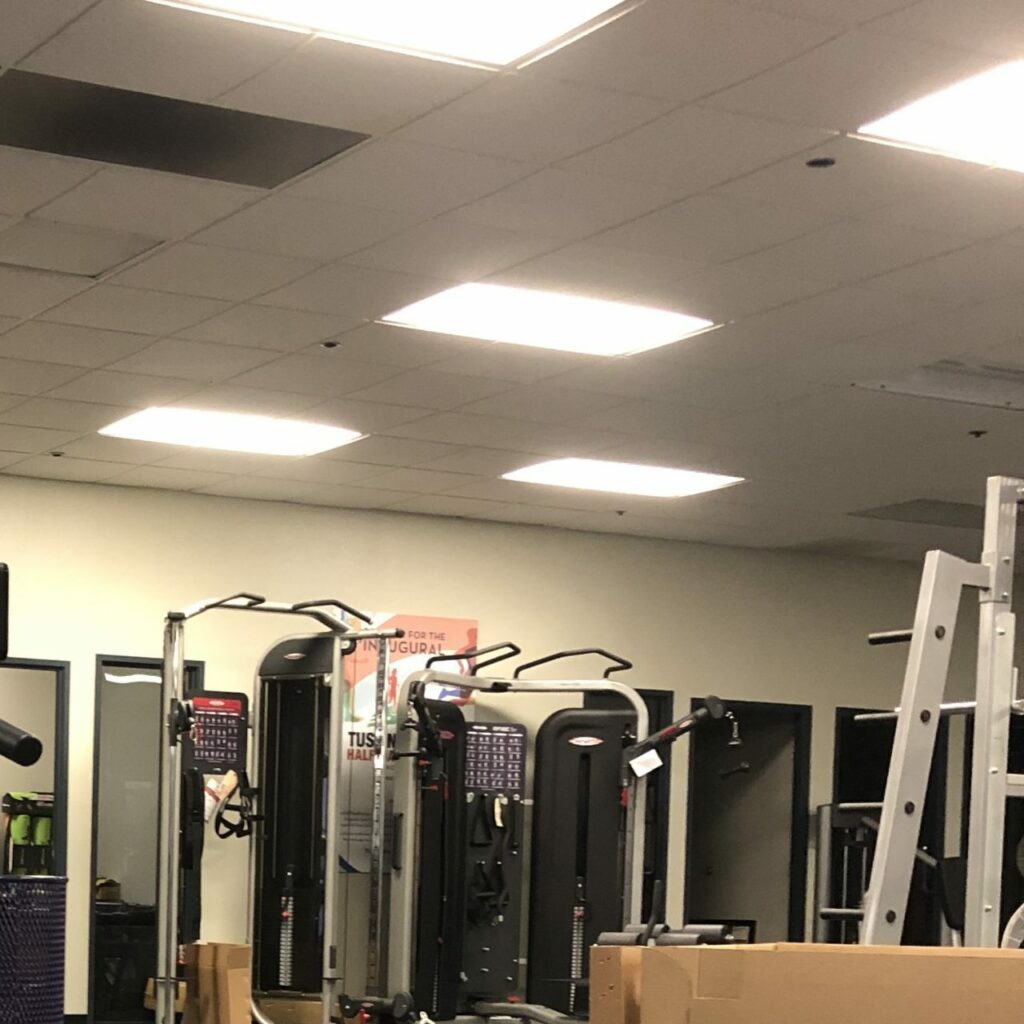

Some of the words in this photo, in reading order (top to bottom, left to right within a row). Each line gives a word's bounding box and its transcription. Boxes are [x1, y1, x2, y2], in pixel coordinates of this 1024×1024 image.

[408, 631, 426, 640] FOR
[429, 632, 446, 641] THE
[363, 640, 444, 656] INUGURAL
[348, 731, 396, 748] TUSN
